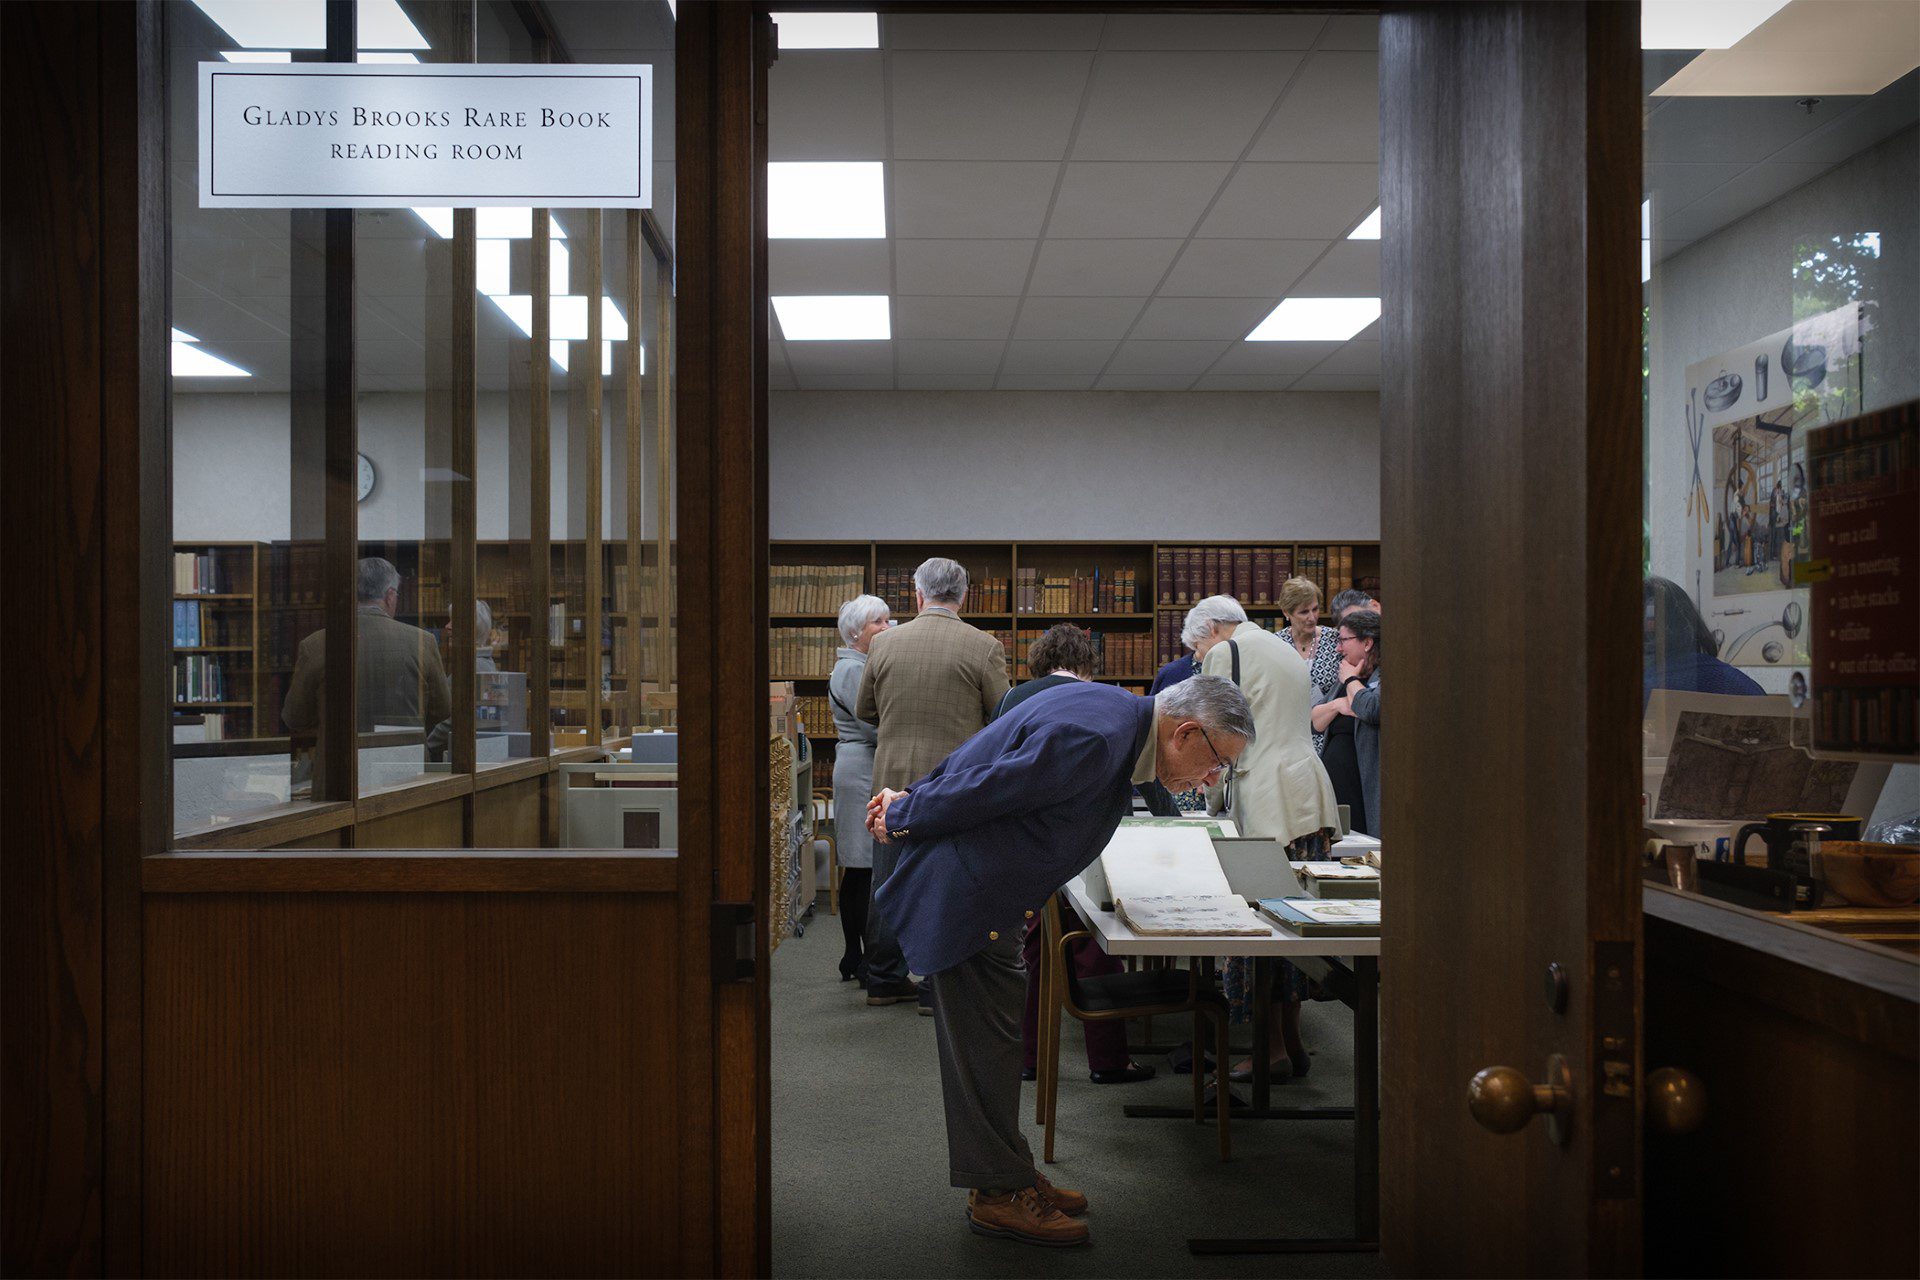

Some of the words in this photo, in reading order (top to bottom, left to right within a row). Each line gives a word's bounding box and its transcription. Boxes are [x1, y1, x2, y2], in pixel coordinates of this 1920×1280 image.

[243, 105, 338, 127] GLADYS
[352, 106, 450, 127] BROOKS
[464, 107, 527, 128] RARE
[541, 108, 611, 128] BOOK
[331, 143, 437, 160] READING
[452, 144, 522, 160] ROOM
